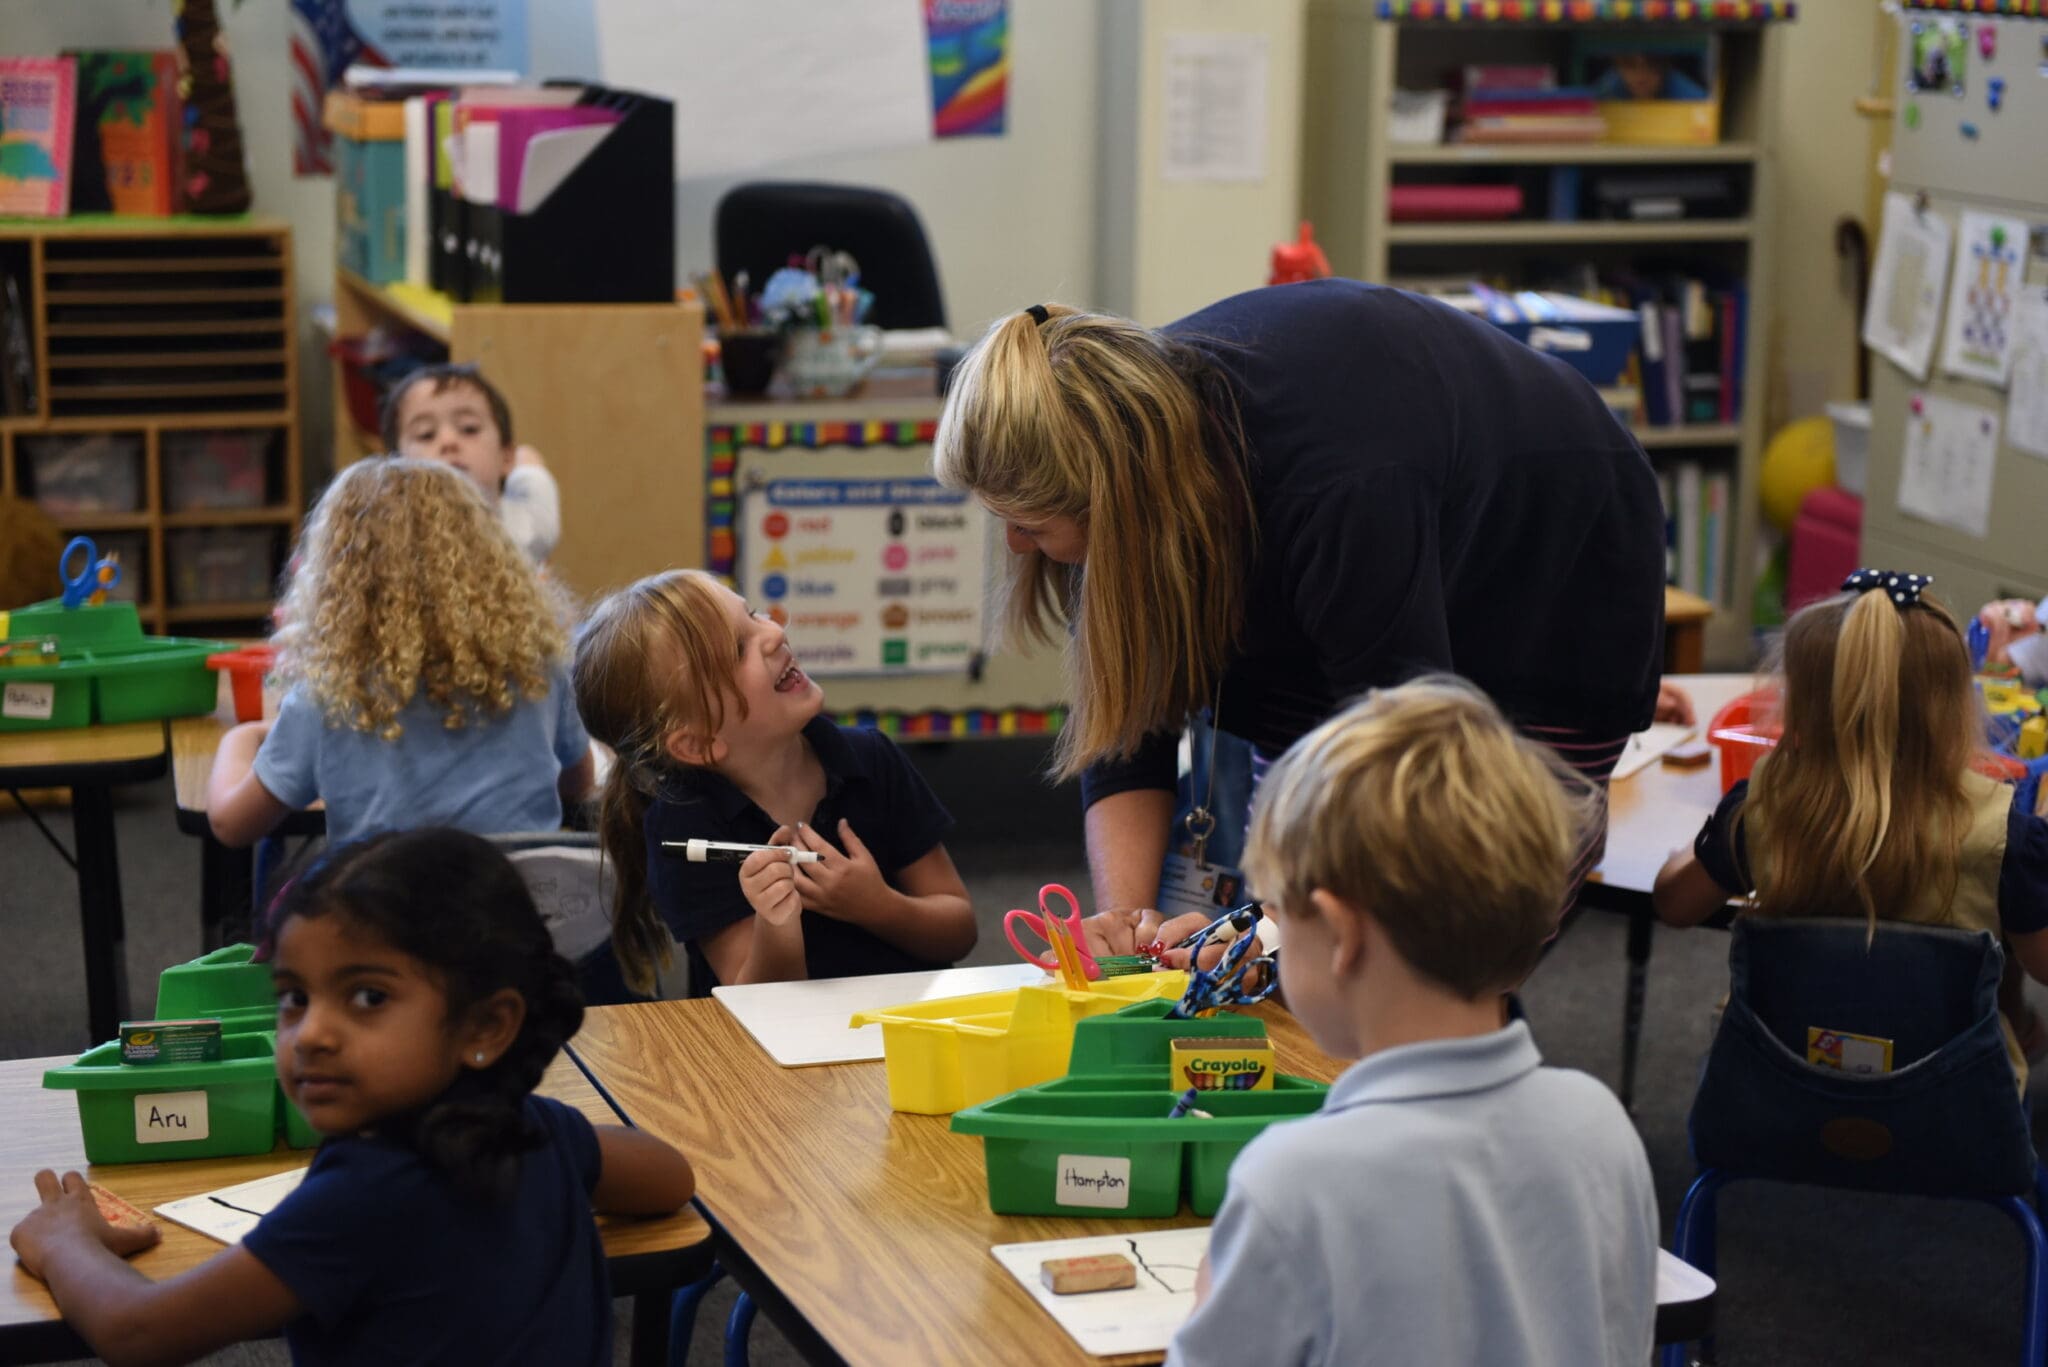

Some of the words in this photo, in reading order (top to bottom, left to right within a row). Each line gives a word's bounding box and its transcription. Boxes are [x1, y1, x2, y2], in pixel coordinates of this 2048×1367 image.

[1191, 1058, 1258, 1074] Crayola
[148, 1106, 187, 1128] Aru
[1064, 1167, 1125, 1193] Hampton
